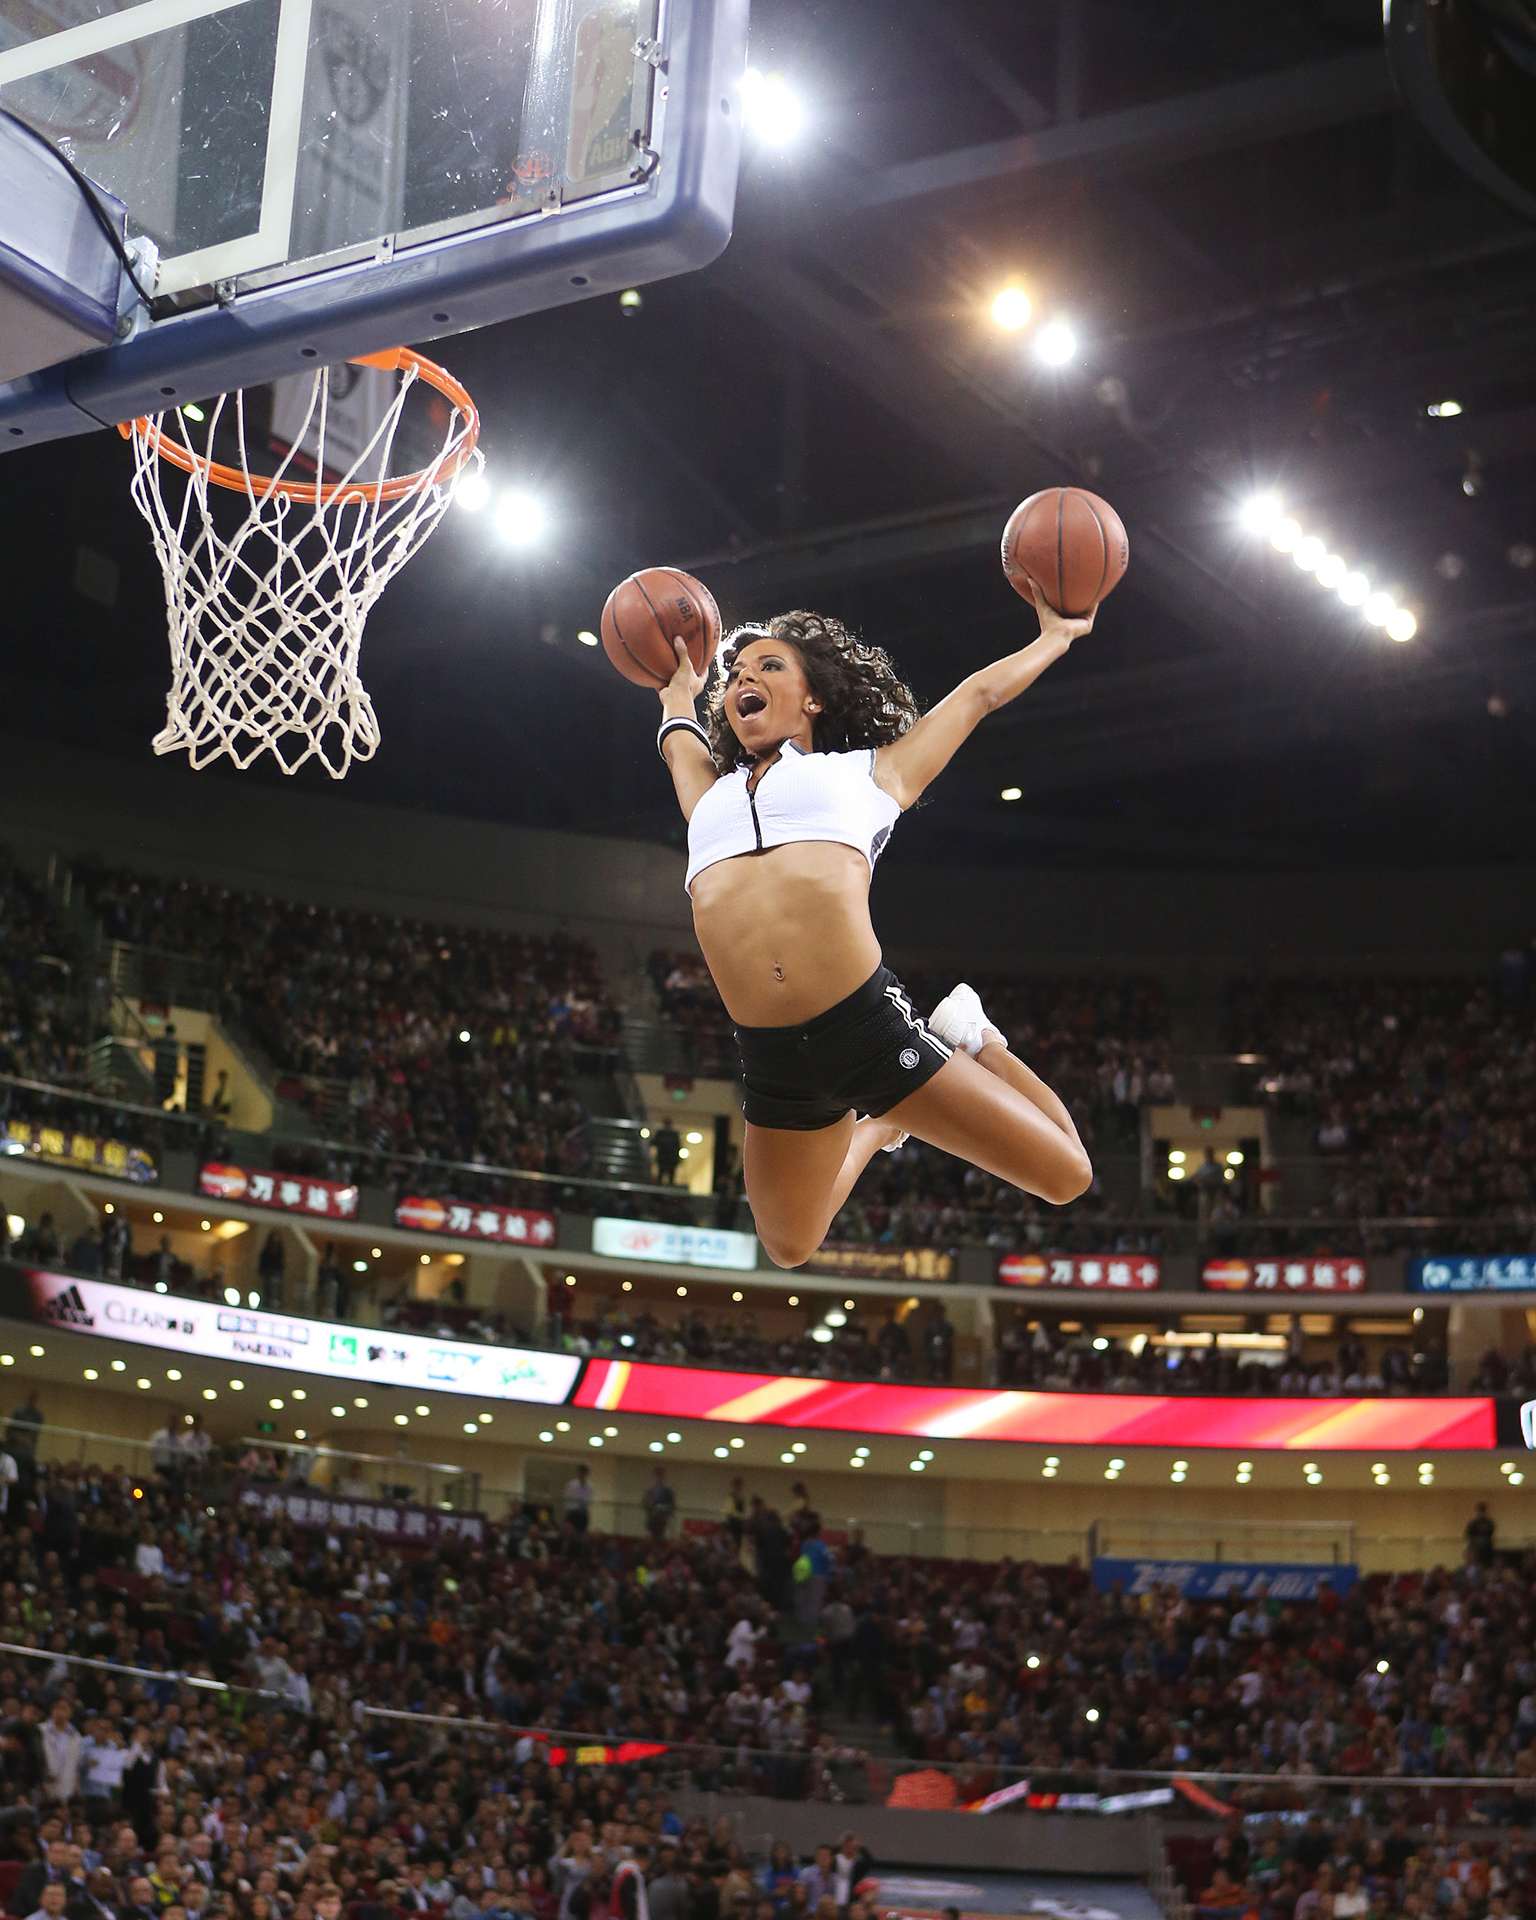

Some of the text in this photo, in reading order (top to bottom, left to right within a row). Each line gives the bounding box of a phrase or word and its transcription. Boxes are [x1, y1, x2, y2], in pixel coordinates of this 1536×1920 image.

[675, 597, 693, 623] NBA
[1050, 1260, 1159, 1287] 万事达卡
[1254, 1263, 1364, 1289] 万事达卡
